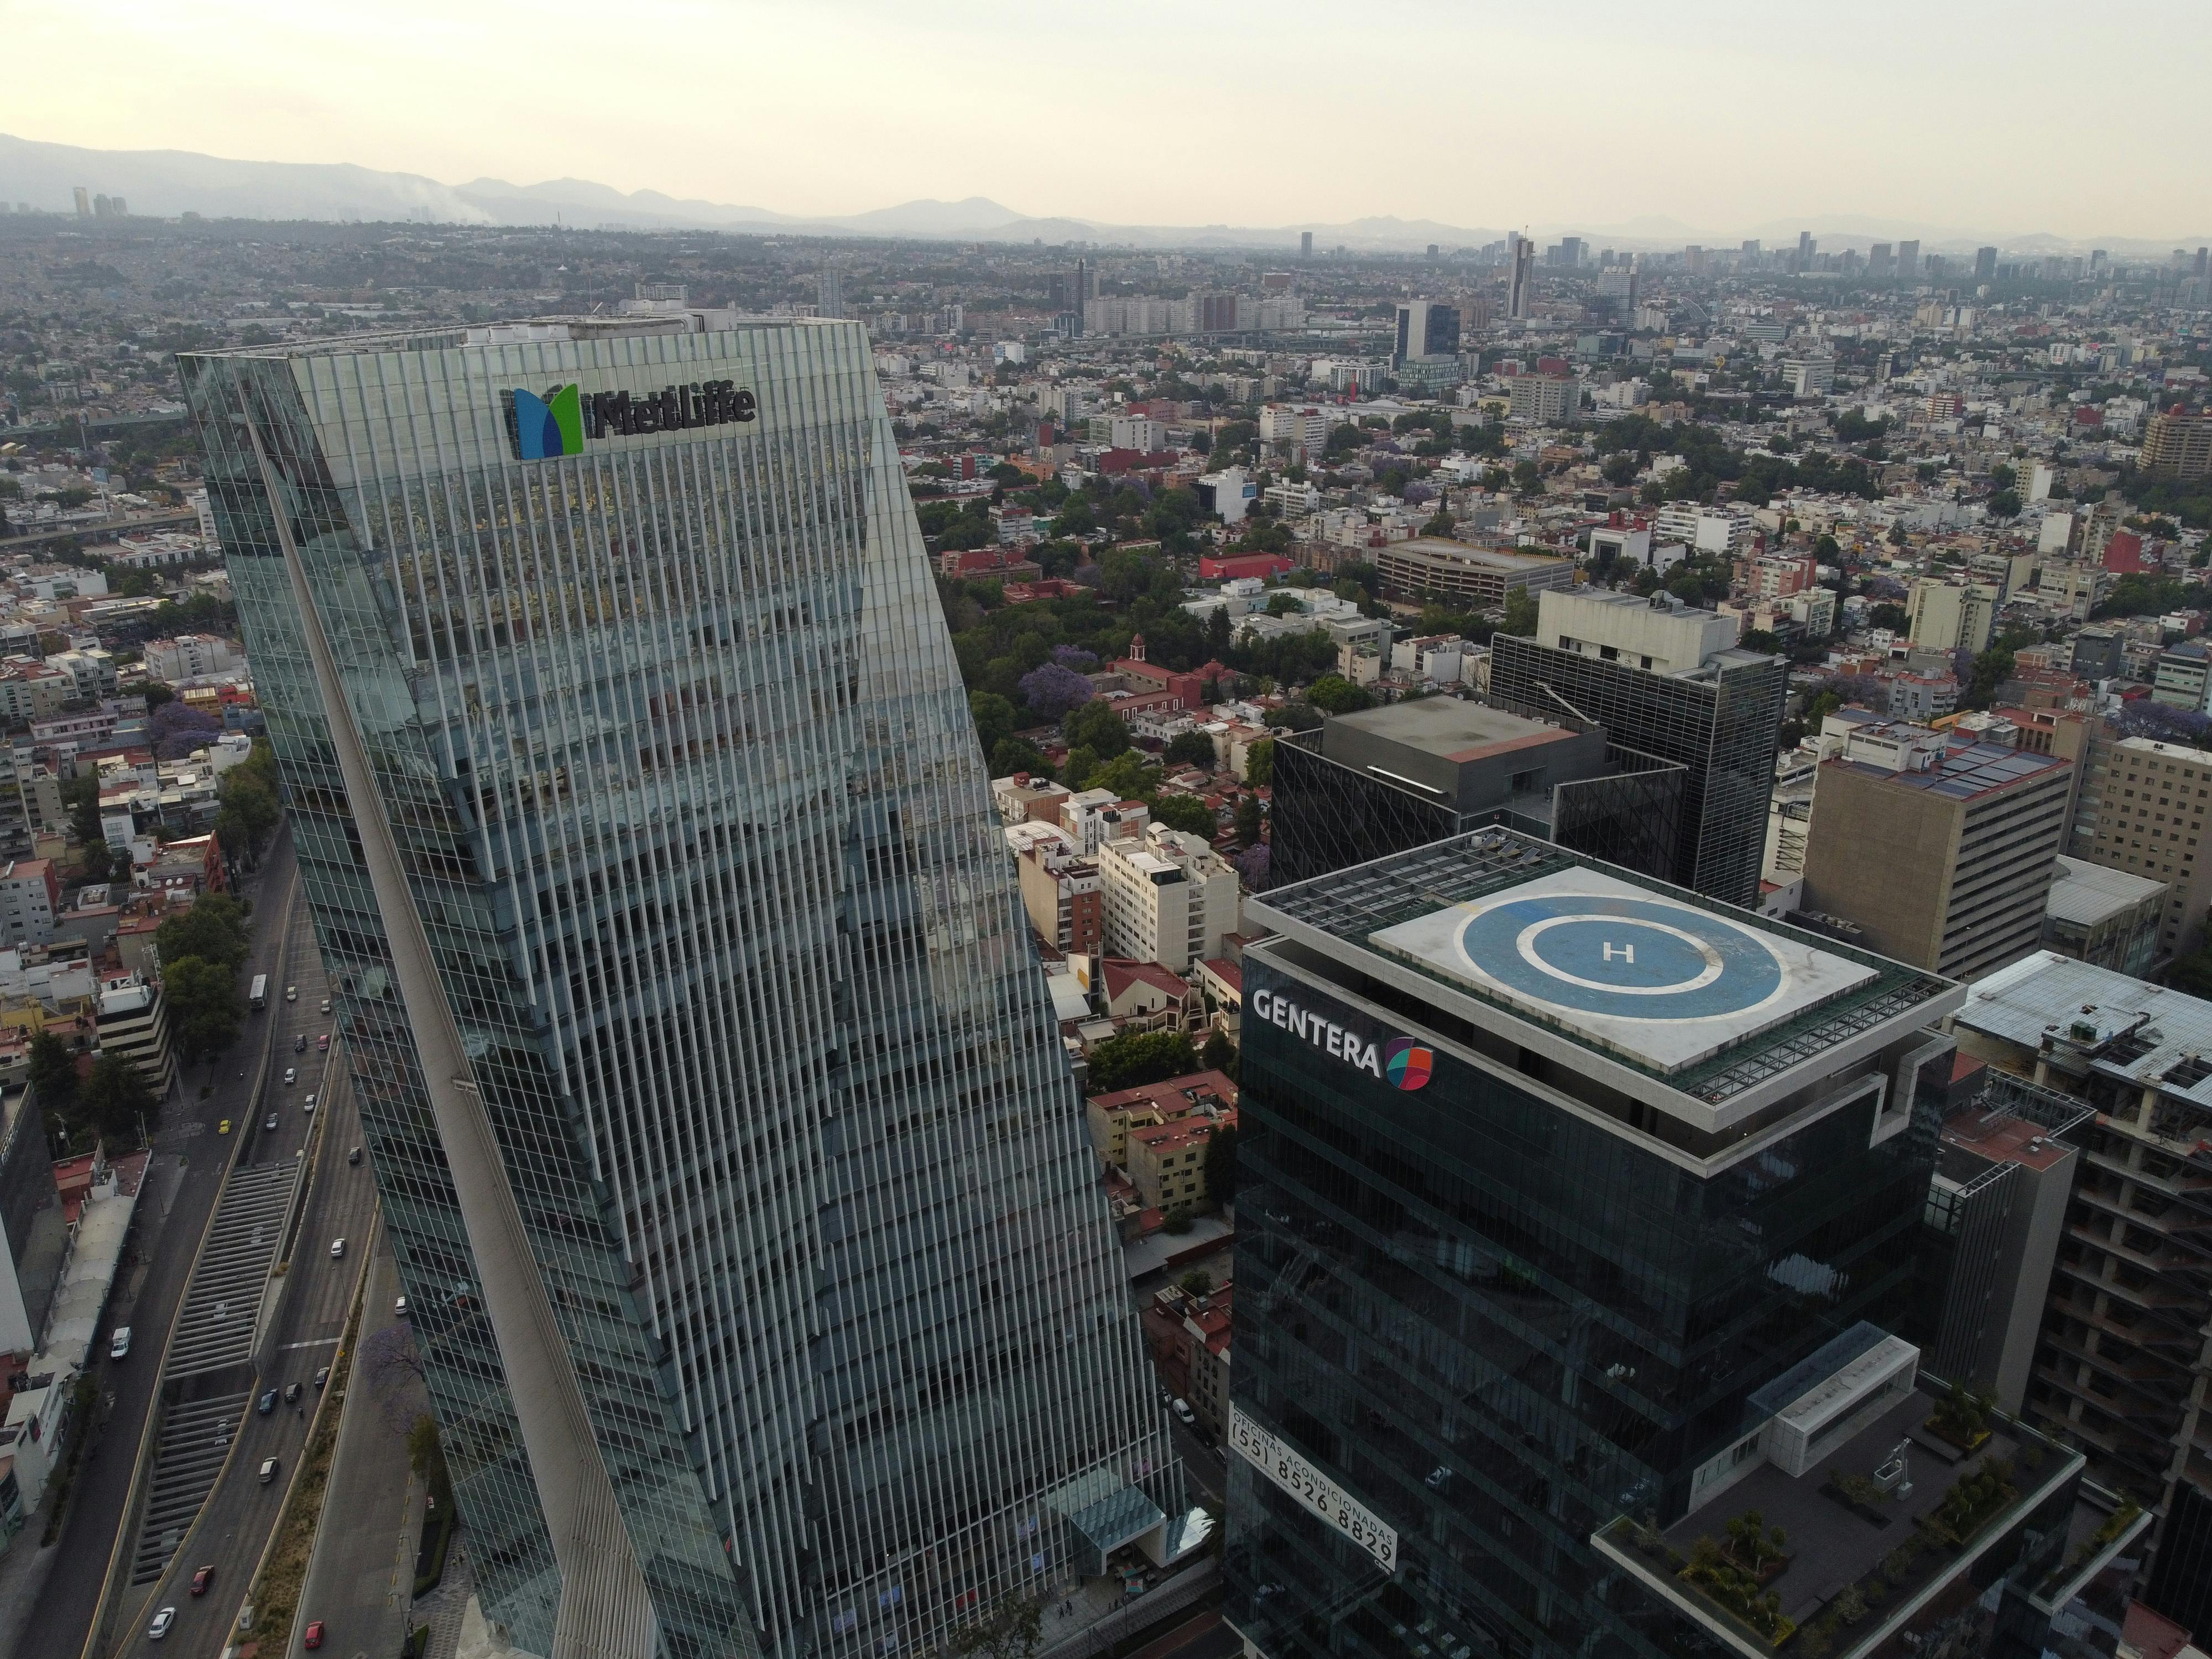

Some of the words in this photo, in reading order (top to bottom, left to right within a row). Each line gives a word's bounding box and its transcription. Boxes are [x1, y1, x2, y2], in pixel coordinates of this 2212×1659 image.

[593, 379, 756, 439] MetLife
[1603, 942, 1634, 963] H
[1253, 989, 1382, 1078] GENTERA
[1233, 1423, 1268, 1465] (55)
[1279, 1460, 1328, 1512] 8526
[1338, 1509, 1392, 1562] 8829
[1234, 1412, 1282, 1457] OFICINAS
[1286, 1455, 1392, 1545] ACONDICIONADAS
[1374, 1559, 1390, 1575] CBRE
